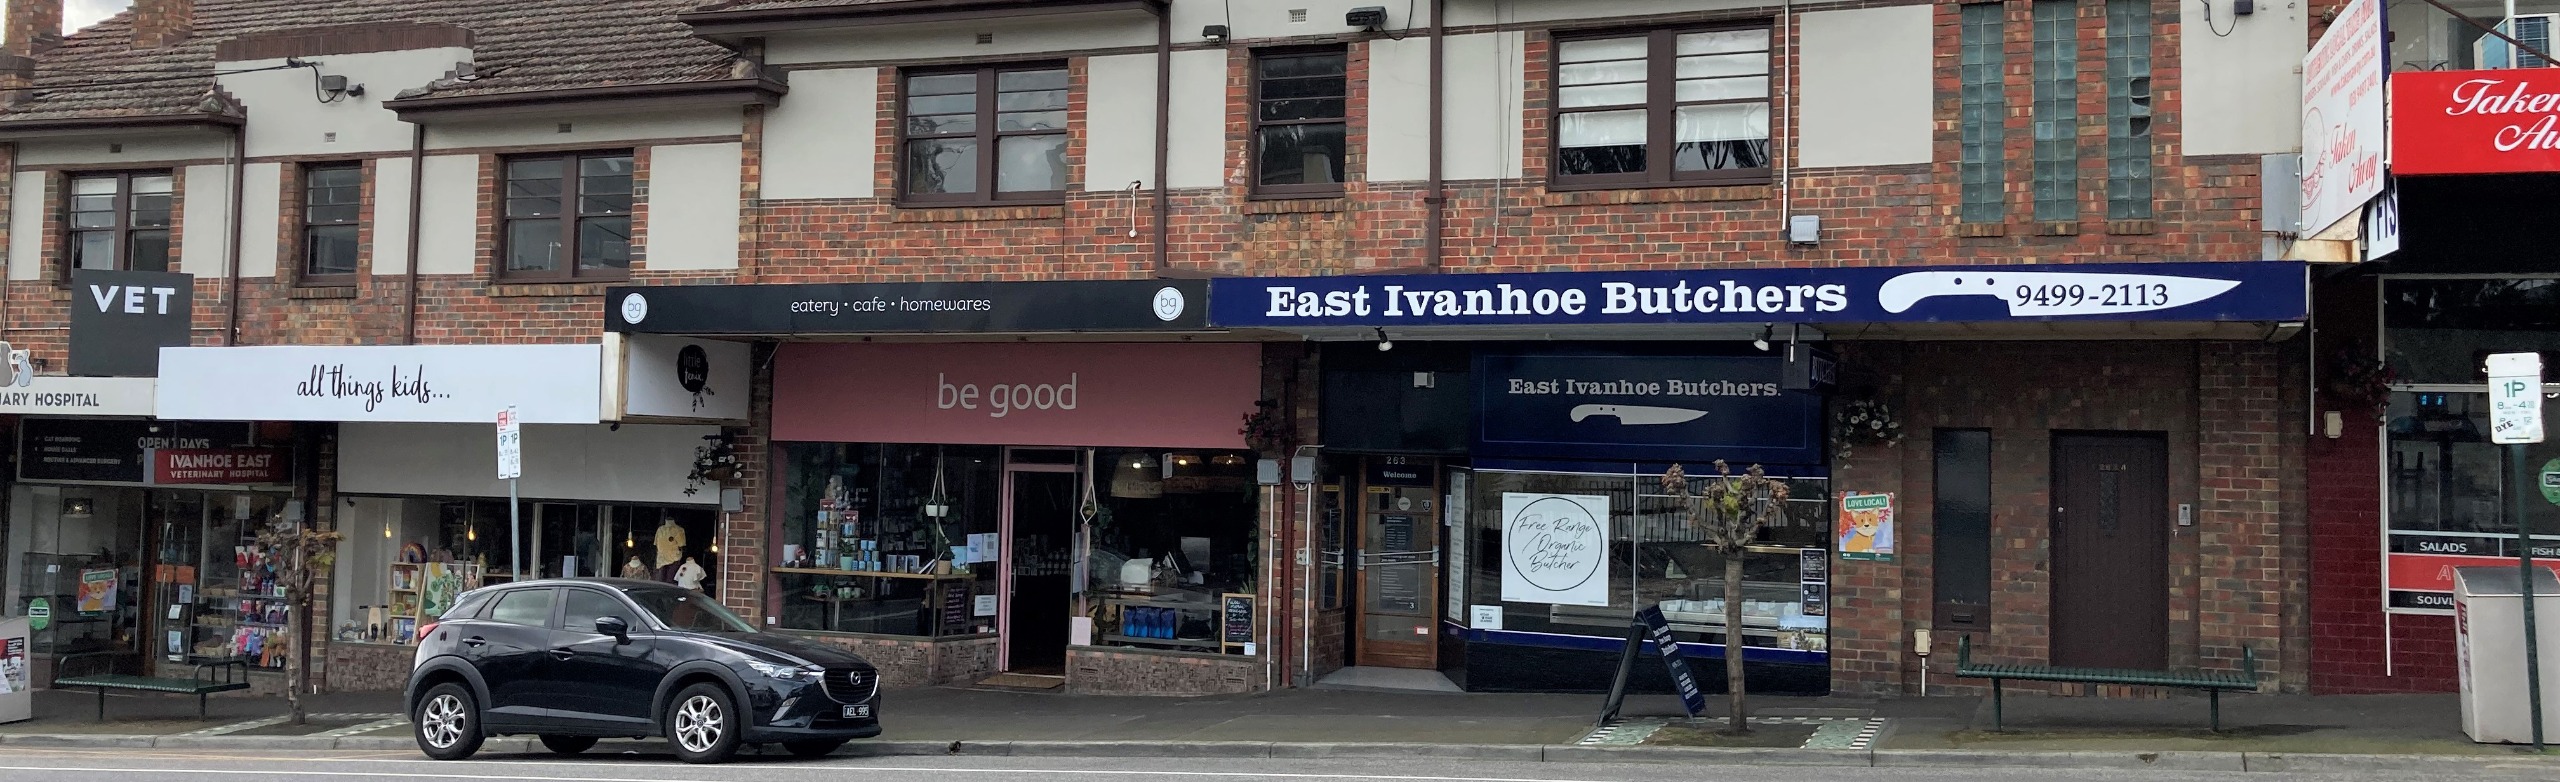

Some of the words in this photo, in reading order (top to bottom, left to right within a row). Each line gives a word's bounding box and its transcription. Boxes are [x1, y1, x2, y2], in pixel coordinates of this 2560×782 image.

[89, 284, 175, 315] VET
[1266, 285, 1371, 318] East
[1383, 282, 1587, 317] Ivanhoe
[1601, 279, 1848, 315] Butchers
[2015, 283, 2170, 307] 9499-2113
[790, 297, 839, 316] eatery
[852, 296, 887, 313] cafe
[899, 296, 991, 313] homewares
[1159, 294, 1177, 316] bg
[297, 364, 324, 397] all
[325, 365, 385, 413] things
[391, 363, 451, 402] kids...
[938, 372, 979, 410] be
[989, 372, 1077, 418] good
[1508, 378, 1560, 396] East
[1566, 378, 1660, 397] Ivanhoe
[2503, 379, 2526, 398] 1P
[35, 392, 100, 407] HOSPITAL
[137, 436, 169, 450] OPEN
[180, 438, 210, 450] DAYS
[170, 454, 231, 469] IVANHOE
[237, 454, 272, 468] EAST
[1386, 456, 1406, 465] 263
[170, 470, 224, 479] VETERINARY
[229, 470, 269, 478] HOSPITAL
[1383, 470, 1417, 479] Welcome
[1847, 499, 1863, 508] LOVE
[1864, 497, 1887, 507] LOCAL!
[1518, 513, 1549, 534] Free
[1553, 517, 1593, 540] Range
[2419, 541, 2467, 553] SALADS
[2531, 547, 2554, 556] FISH
[1529, 551, 1581, 573] Butcher
